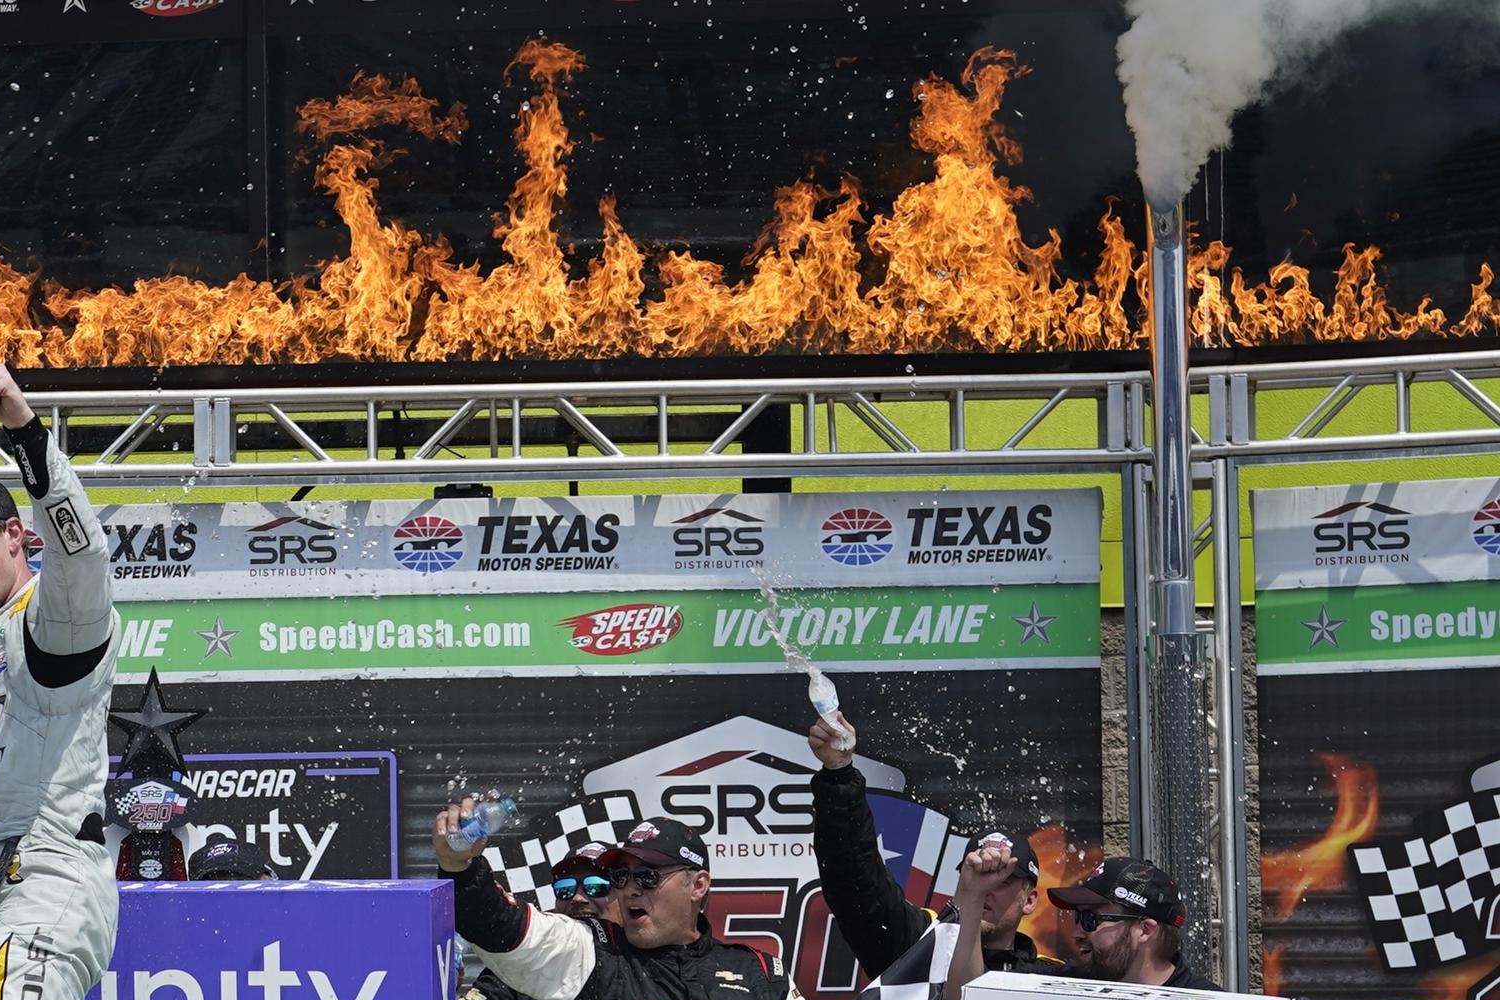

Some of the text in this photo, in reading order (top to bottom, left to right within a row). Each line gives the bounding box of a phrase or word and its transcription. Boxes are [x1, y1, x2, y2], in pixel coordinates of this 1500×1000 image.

[478, 514, 619, 554] TEXAS
[907, 505, 1052, 547] TEXAS
[1313, 520, 1410, 553] SRS
[103, 523, 197, 563] XAS
[249, 536, 337, 564] SRS
[673, 527, 764, 556] SRS
[477, 556, 614, 571] MOTOR SPEEDWAY
[675, 560, 764, 569] DISTRIBUTION
[907, 548, 1046, 564] MOTOR SPEEDWAY
[1315, 554, 1409, 566] DISTRIBUTION
[113, 564, 191, 580] SPEEDWAY
[250, 568, 336, 576] DISTRIBUTION
[595, 605, 679, 633] SPEEDY
[712, 604, 989, 648] VICTORY LANE
[1370, 607, 1500, 643] Speedy
[259, 619, 530, 653] SpeedyCash.com
[597, 630, 670, 649] CA$H
[140, 789, 163, 798] SRS
[181, 769, 296, 799] NASCAR
[129, 804, 173, 823] 250
[661, 784, 815, 835] SRS
[1127, 891, 1148, 904] TEXAS
